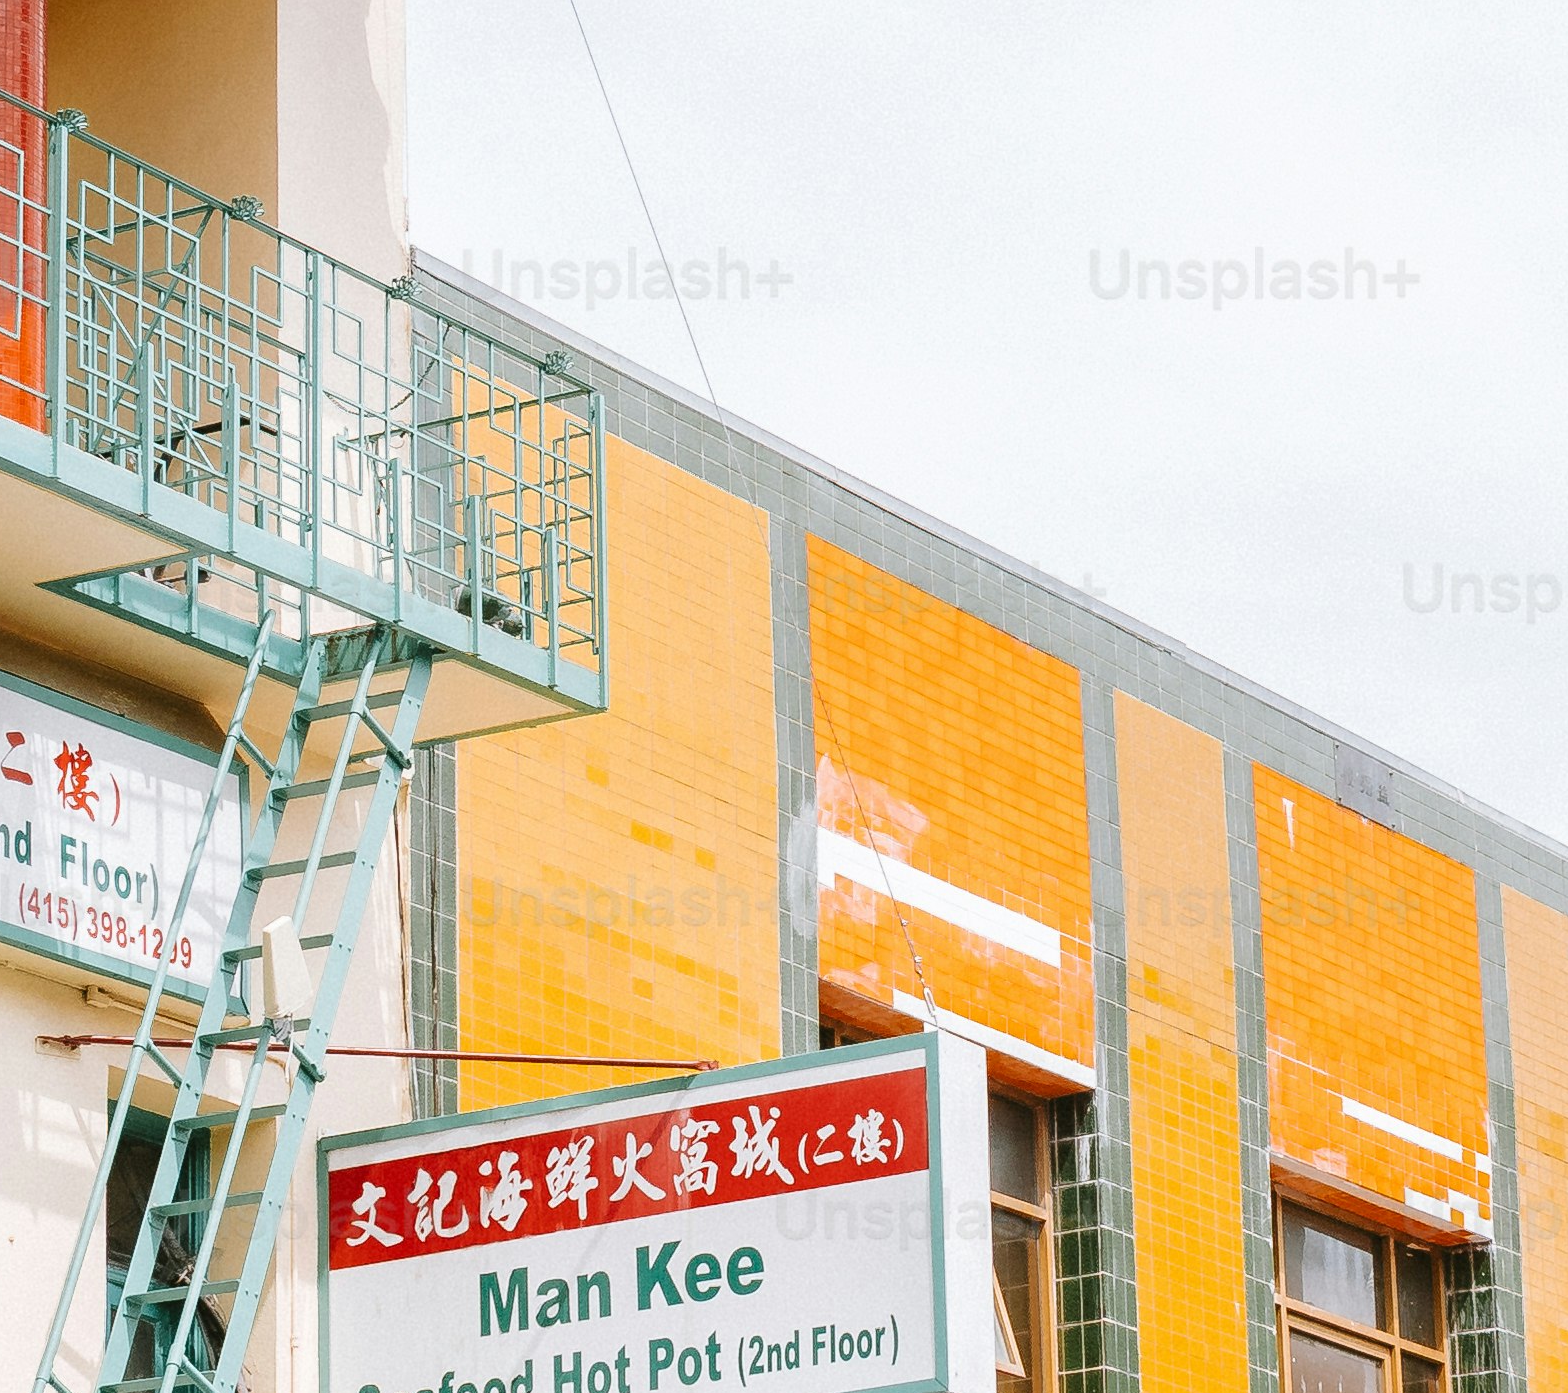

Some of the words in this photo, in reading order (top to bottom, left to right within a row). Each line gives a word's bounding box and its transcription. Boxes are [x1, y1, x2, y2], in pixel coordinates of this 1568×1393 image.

[19, 882, 78, 942] (415)
[60, 833, 159, 921] Floor)
[478, 1264, 612, 1337] Man
[636, 1238, 766, 1310] Kee
[648, 1333, 723, 1392] Pot
[737, 1328, 802, 1388] (2nd
[812, 1314, 901, 1368] Floor)
